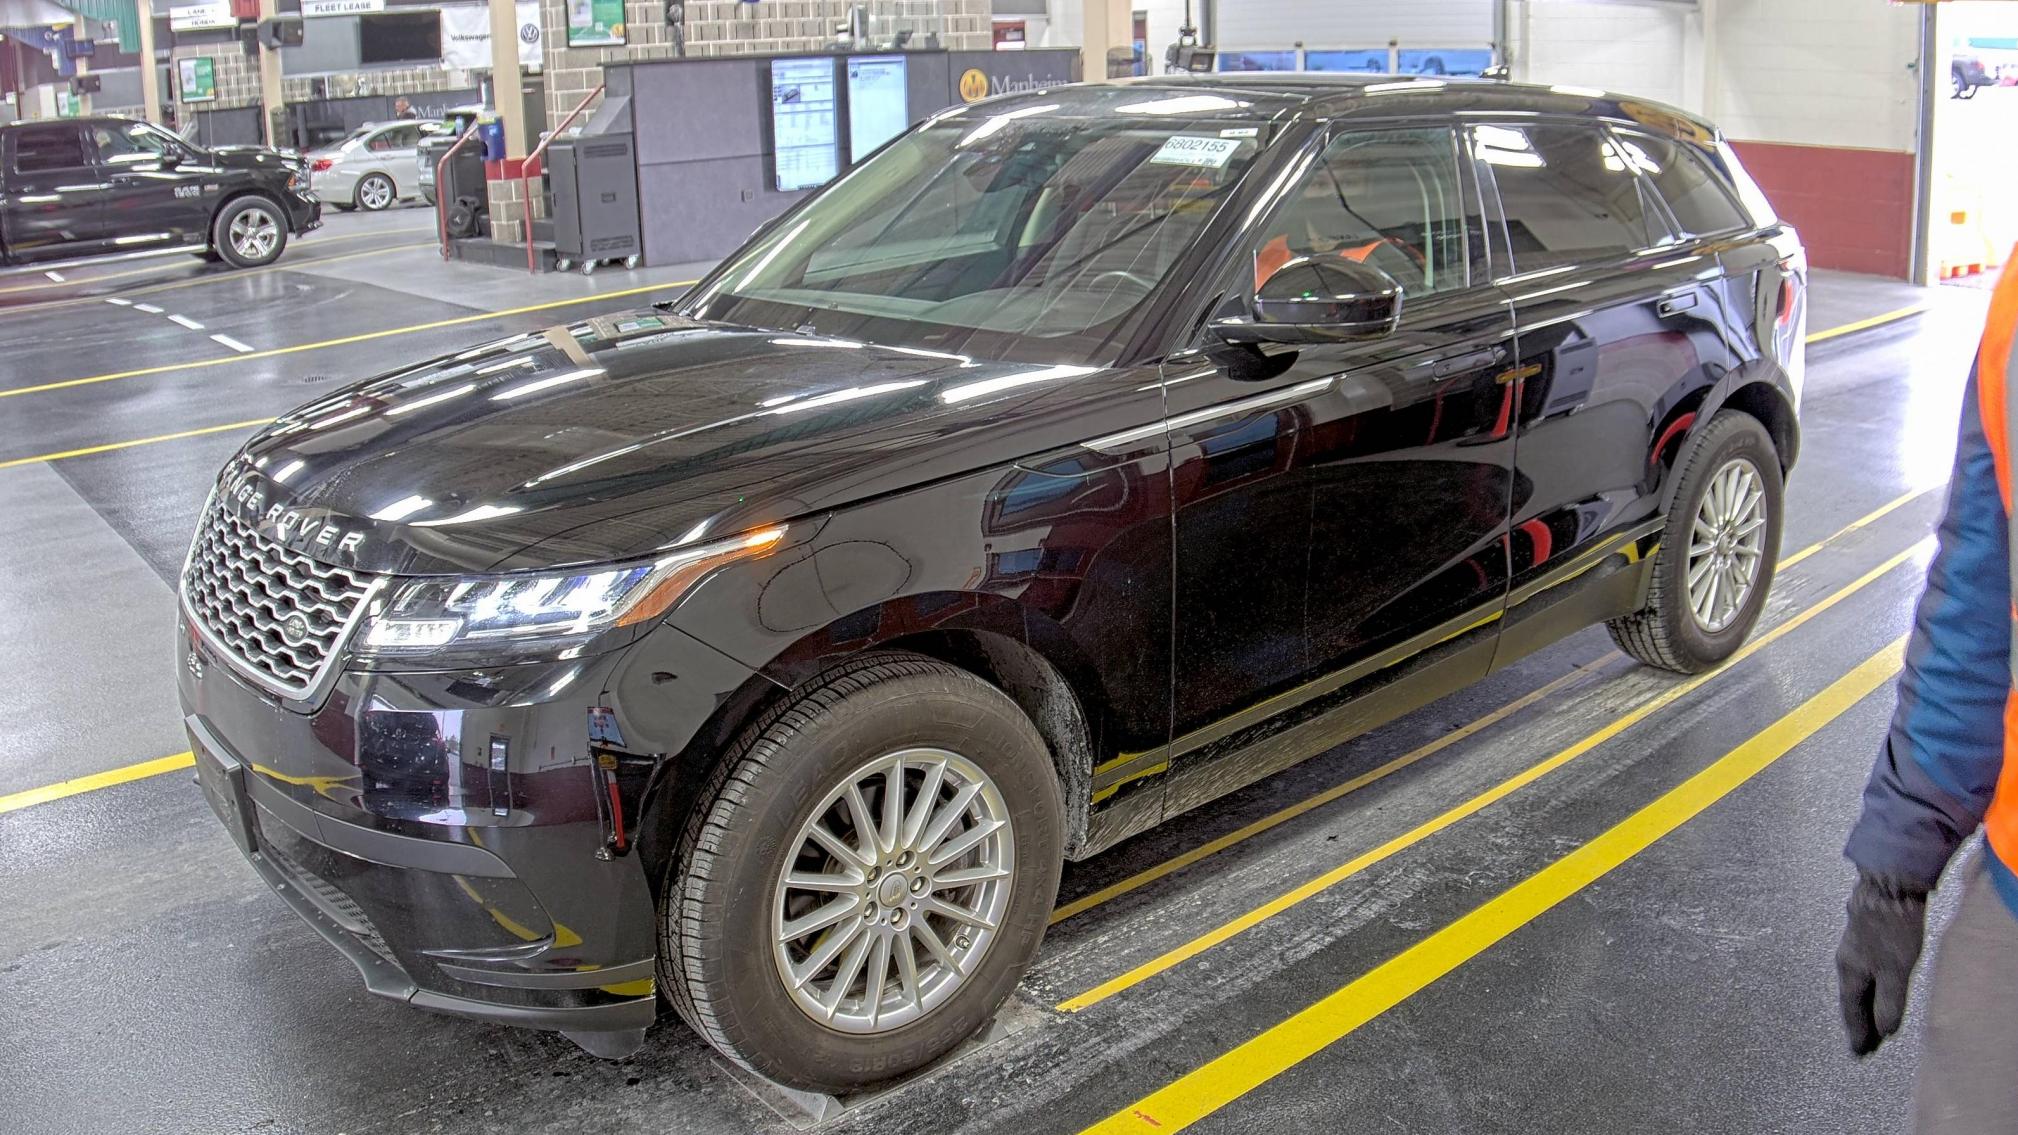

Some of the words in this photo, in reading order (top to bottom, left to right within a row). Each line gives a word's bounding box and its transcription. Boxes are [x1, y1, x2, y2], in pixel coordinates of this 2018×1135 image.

[314, 3, 341, 13] FLEET
[344, 1, 371, 11] LEASE
[266, 503, 366, 552] ROVER
